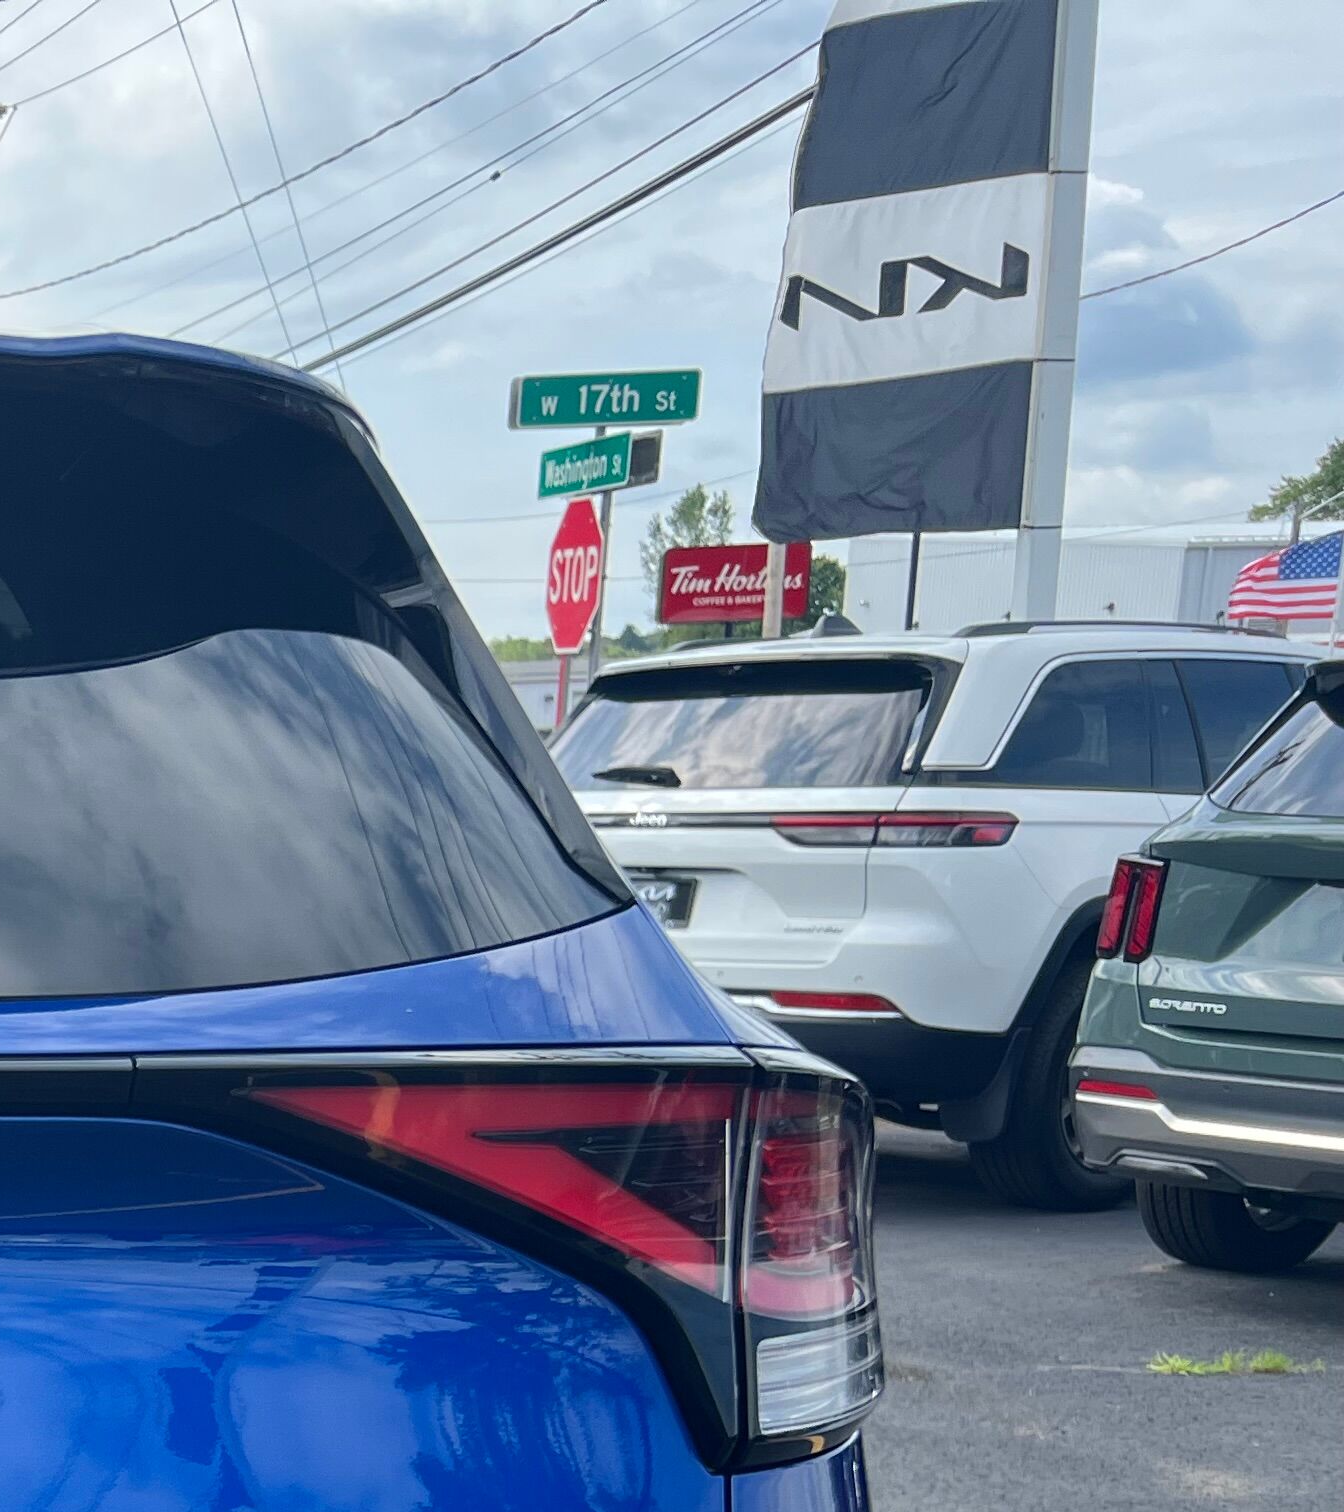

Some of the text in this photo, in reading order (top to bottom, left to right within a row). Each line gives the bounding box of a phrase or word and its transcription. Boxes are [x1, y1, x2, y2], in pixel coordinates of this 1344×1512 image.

[540, 383, 678, 417] W 17th St
[544, 450, 623, 490] Washington St
[549, 545, 599, 605] STOP
[670, 563, 804, 595] Tim Hortns
[692, 596, 726, 607] COFFEE
[629, 806, 668, 829] Jeep
[1149, 998, 1227, 1014] SORENTO
